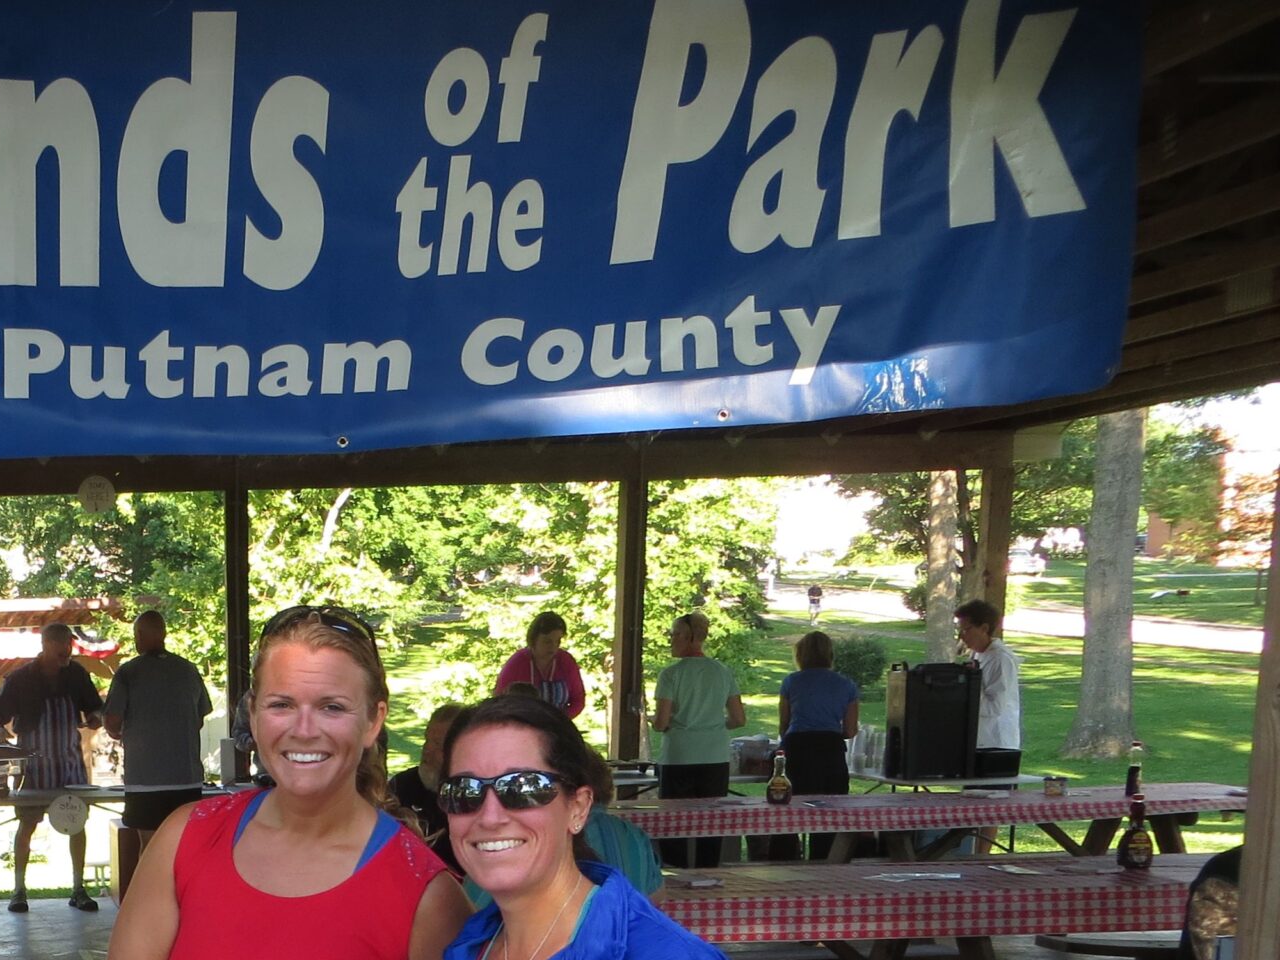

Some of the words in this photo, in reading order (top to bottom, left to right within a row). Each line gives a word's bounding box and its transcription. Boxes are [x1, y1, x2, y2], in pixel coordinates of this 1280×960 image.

[424, 13, 549, 147] of
[609, 0, 1087, 266] Park
[396, 156, 545, 280] the
[3, 328, 412, 400] Putnam
[460, 295, 843, 386] County
